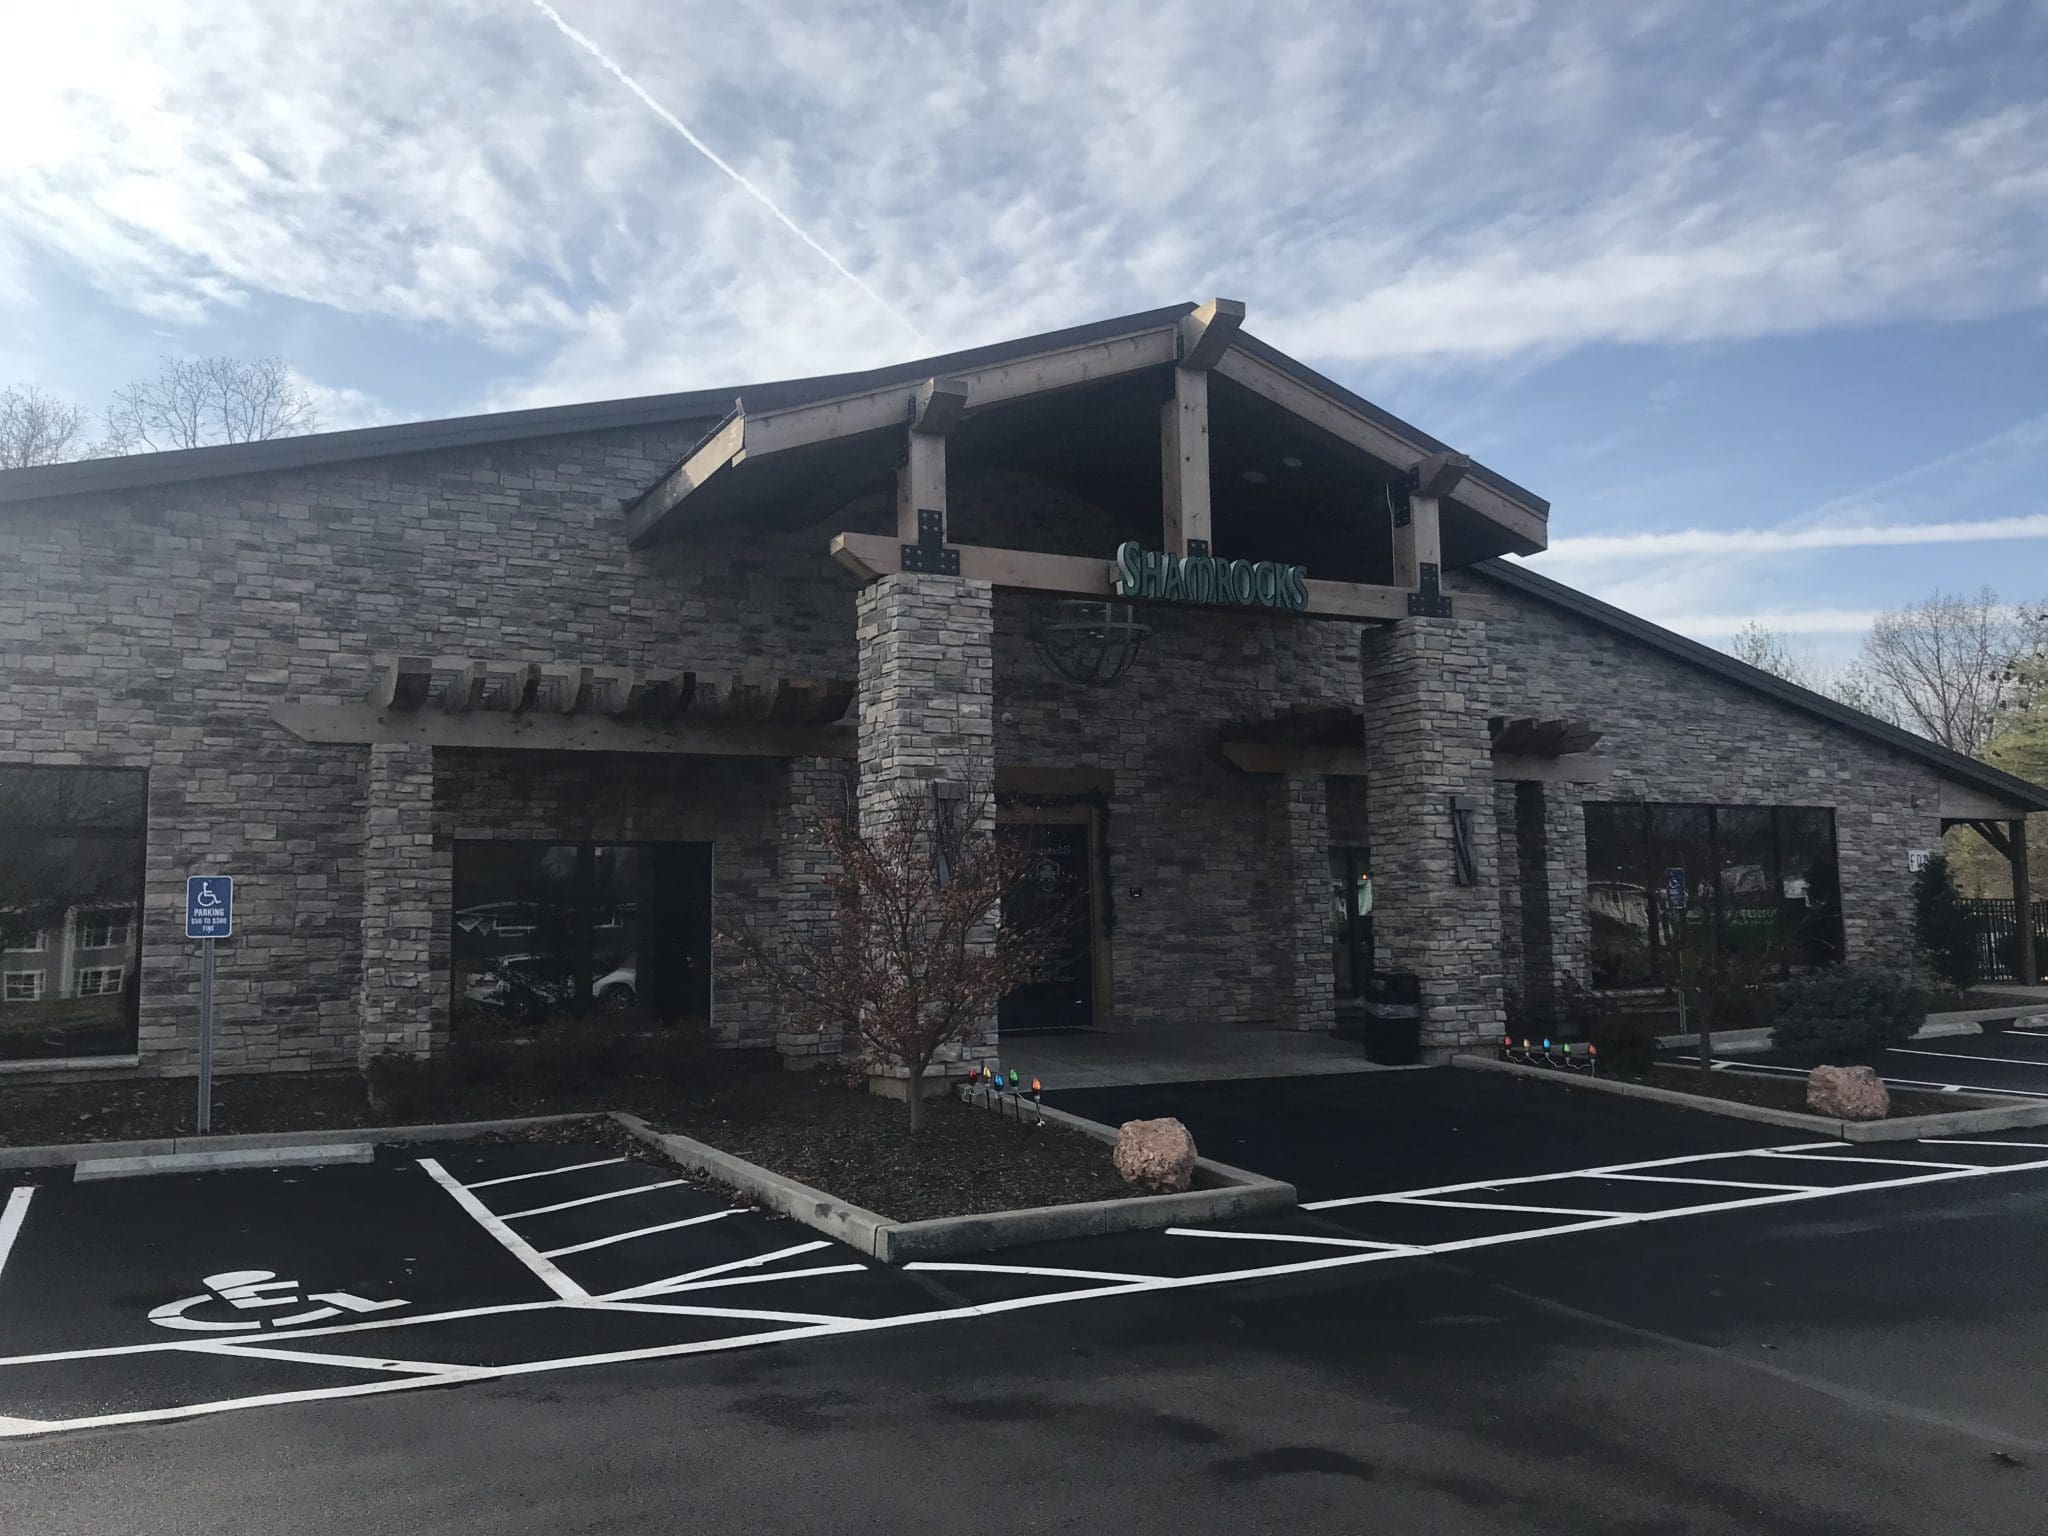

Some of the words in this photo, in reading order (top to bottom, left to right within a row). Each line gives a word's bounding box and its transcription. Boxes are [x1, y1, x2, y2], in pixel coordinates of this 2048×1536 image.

[1116, 541, 1308, 611] SHAMROCKS
[193, 908, 225, 917] PARKING
[203, 917, 211, 925] TO
